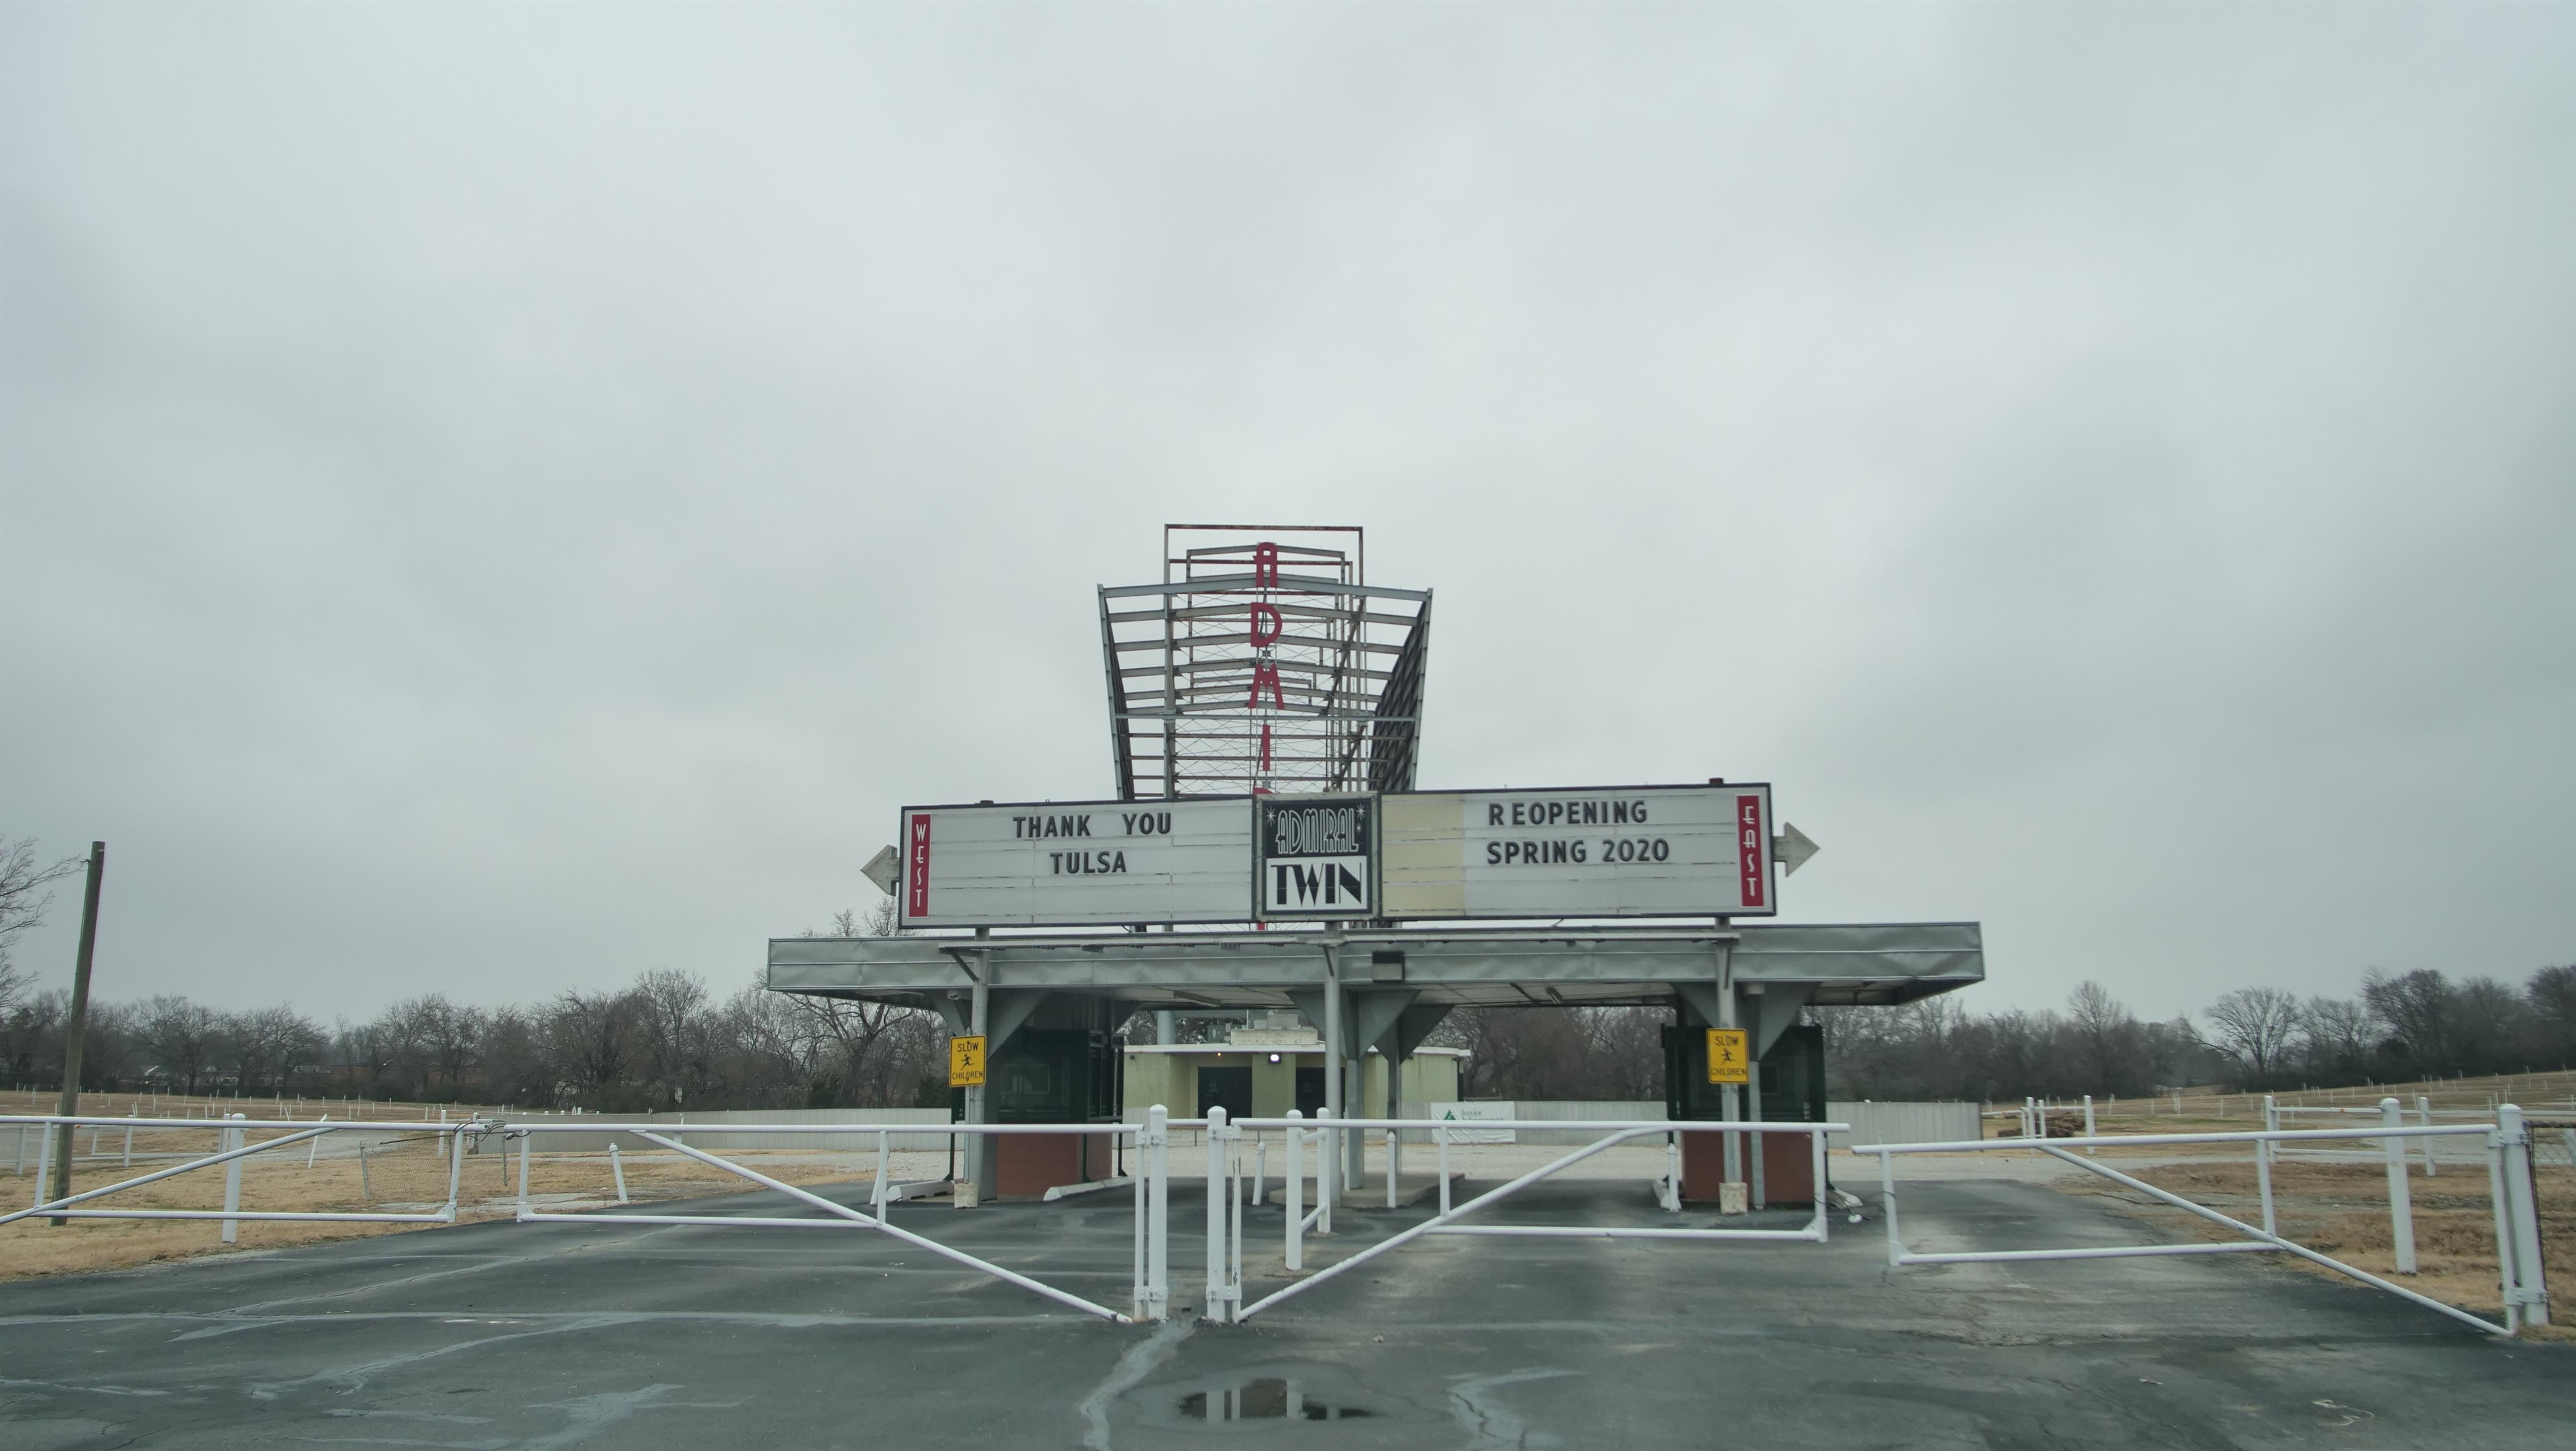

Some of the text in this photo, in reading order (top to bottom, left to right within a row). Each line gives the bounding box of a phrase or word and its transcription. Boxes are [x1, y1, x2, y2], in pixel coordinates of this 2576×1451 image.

[1247, 541, 1285, 794] ADMI
[1013, 812, 1171, 838] THANK YOU
[1489, 800, 1648, 825] REOPENING
[1275, 808, 1359, 855] ADMIRAL
[1049, 851, 1127, 875] TULSA
[1487, 838, 1669, 864] SPRING 2020
[1742, 805, 1758, 897] EAST
[915, 824, 927, 908] WEST
[1270, 861, 1362, 907] TWIN
[957, 1042, 979, 1053] SLOW
[1715, 1036, 1739, 1046] SLOW
[952, 1071, 983, 1079] CHILDREN
[1711, 1067, 1747, 1075] CHILDREN
